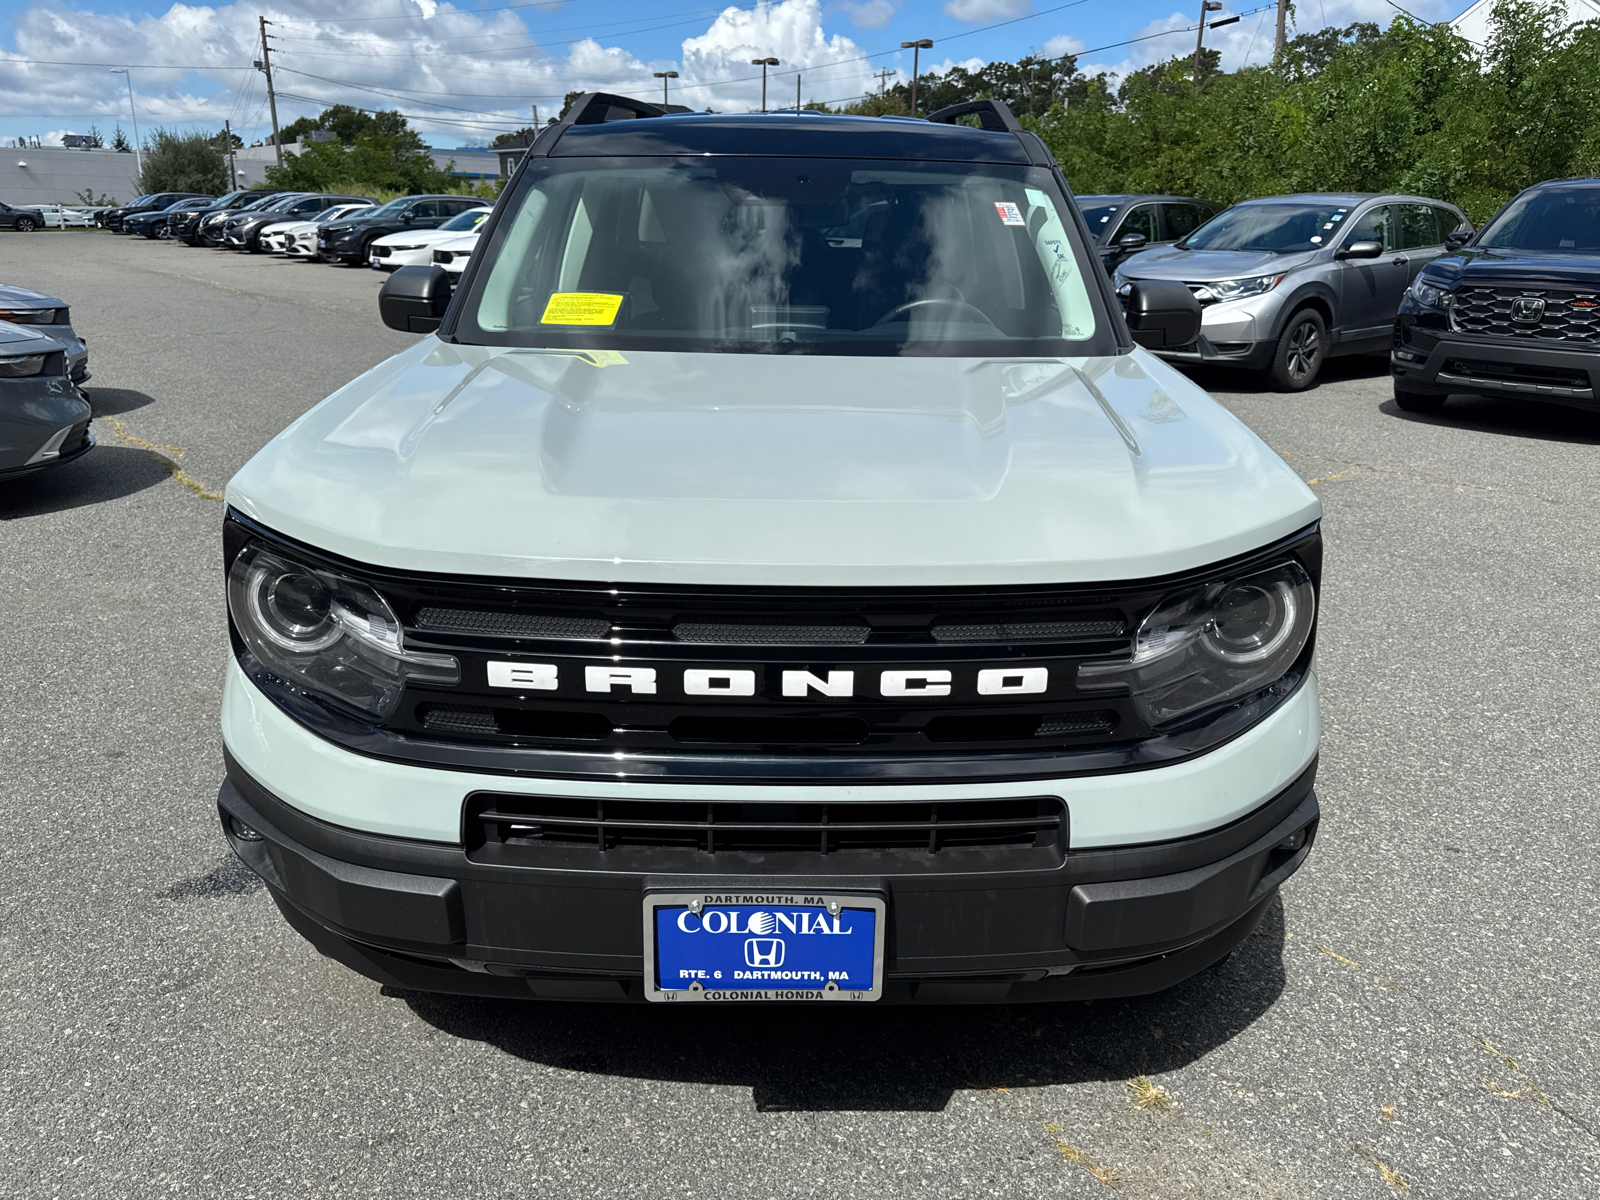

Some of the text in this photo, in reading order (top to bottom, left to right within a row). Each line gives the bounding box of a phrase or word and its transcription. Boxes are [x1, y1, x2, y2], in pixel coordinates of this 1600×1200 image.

[487, 661, 1049, 697] BRONCO
[803, 896, 825, 906] MA
[677, 911, 853, 935] COLONIAL
[679, 969, 849, 981] RTE. 6 DARTMOUTH, MA
[703, 991, 824, 1001] COLONIAL HONDA
